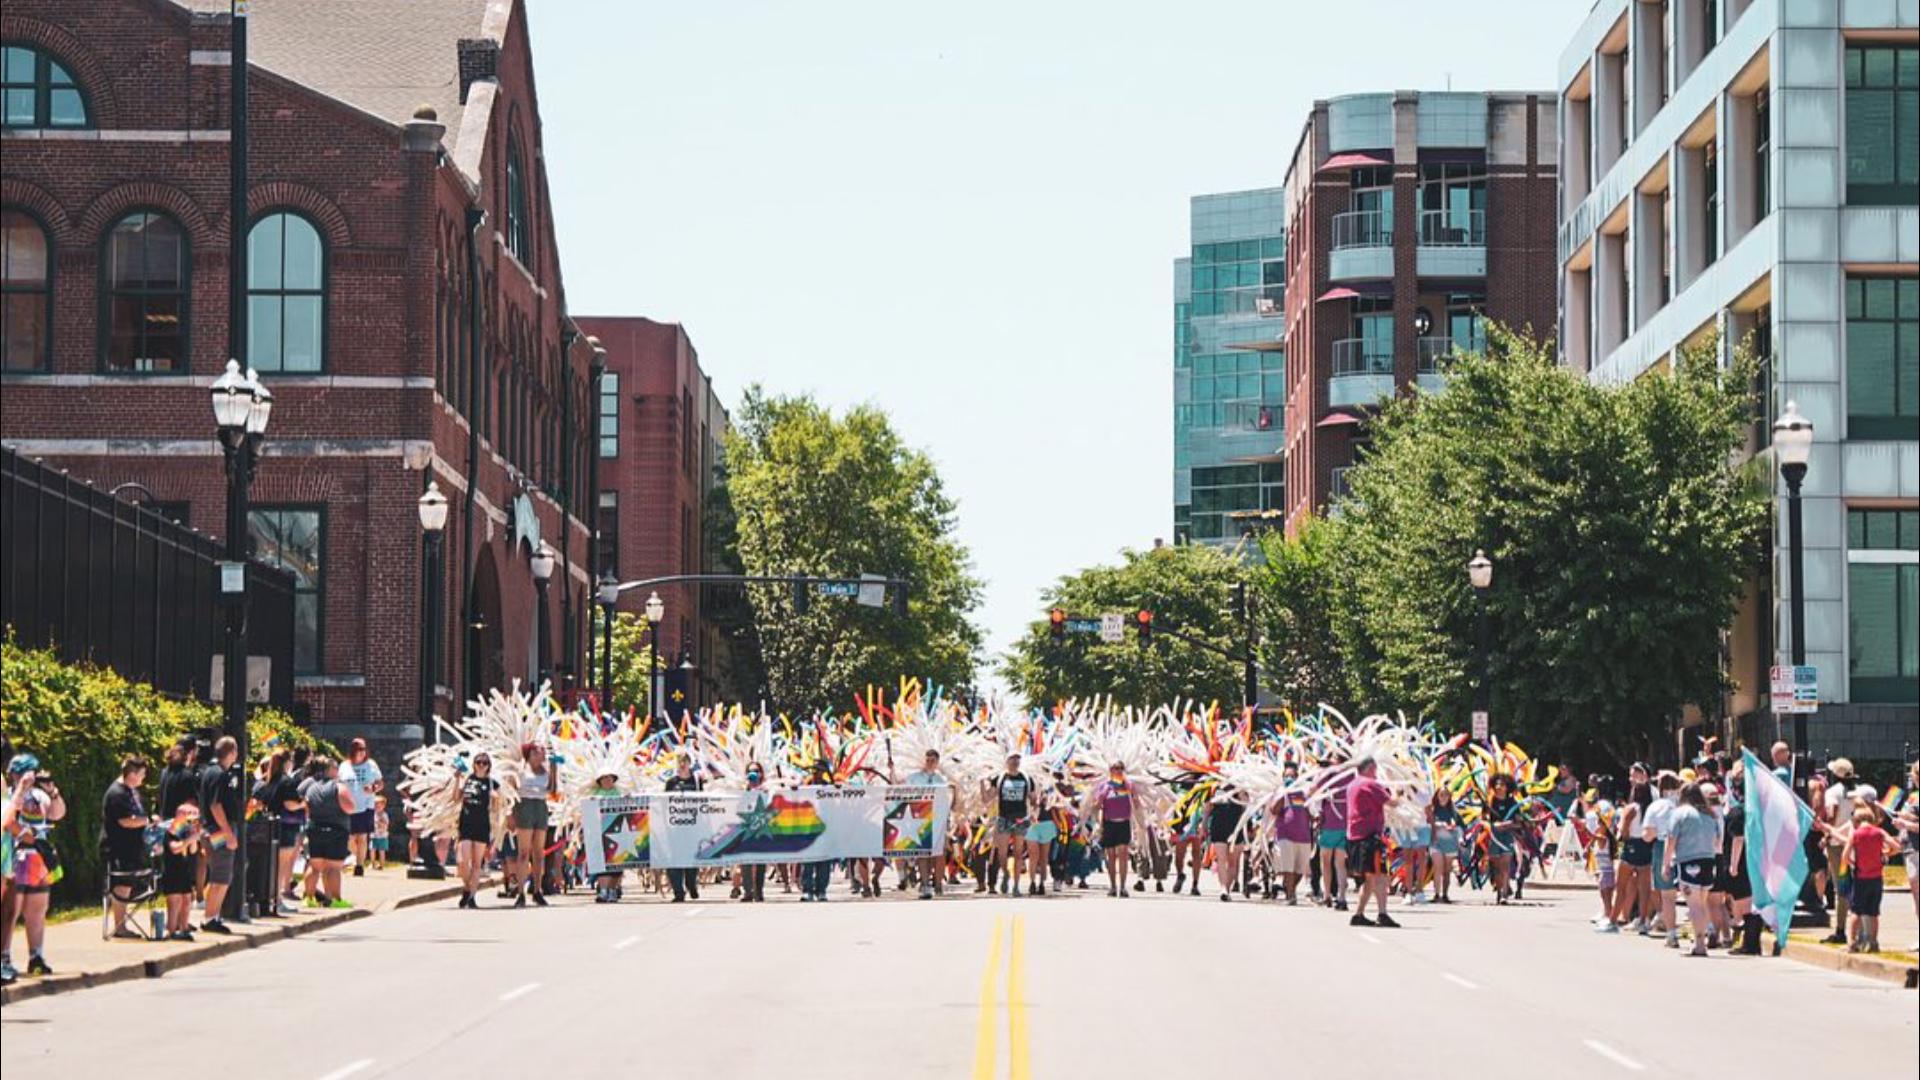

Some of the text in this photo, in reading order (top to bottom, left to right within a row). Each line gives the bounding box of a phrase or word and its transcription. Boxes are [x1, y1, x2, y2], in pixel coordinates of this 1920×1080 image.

[816, 789, 866, 799] Since 1999
[669, 805, 726, 816] Doing Cities
[669, 817, 697, 825] Good
